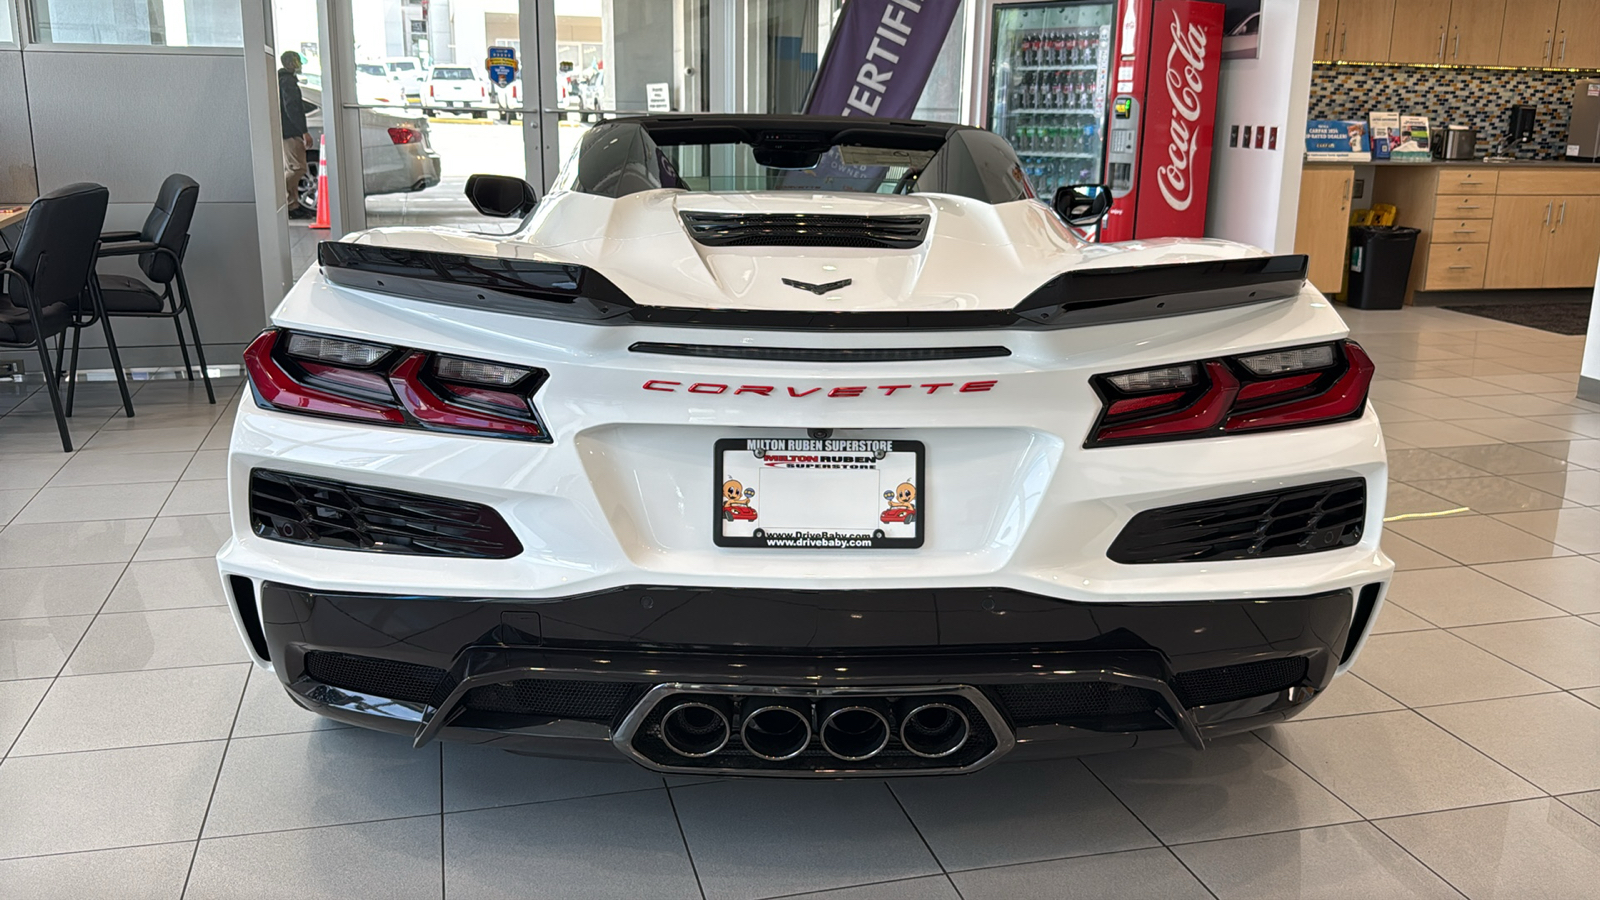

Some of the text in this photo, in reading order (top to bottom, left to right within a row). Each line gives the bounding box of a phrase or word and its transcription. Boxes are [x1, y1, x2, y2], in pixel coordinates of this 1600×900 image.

[842, 0, 924, 117] ERTIFI
[1157, 9, 1207, 211] Coca-Cola
[642, 380, 999, 398] CORVETTE
[747, 440, 893, 452] MILTON RUBEN SUPERSTORE
[764, 455, 818, 463] MILTON
[767, 538, 872, 548] www.drivebaby.com
